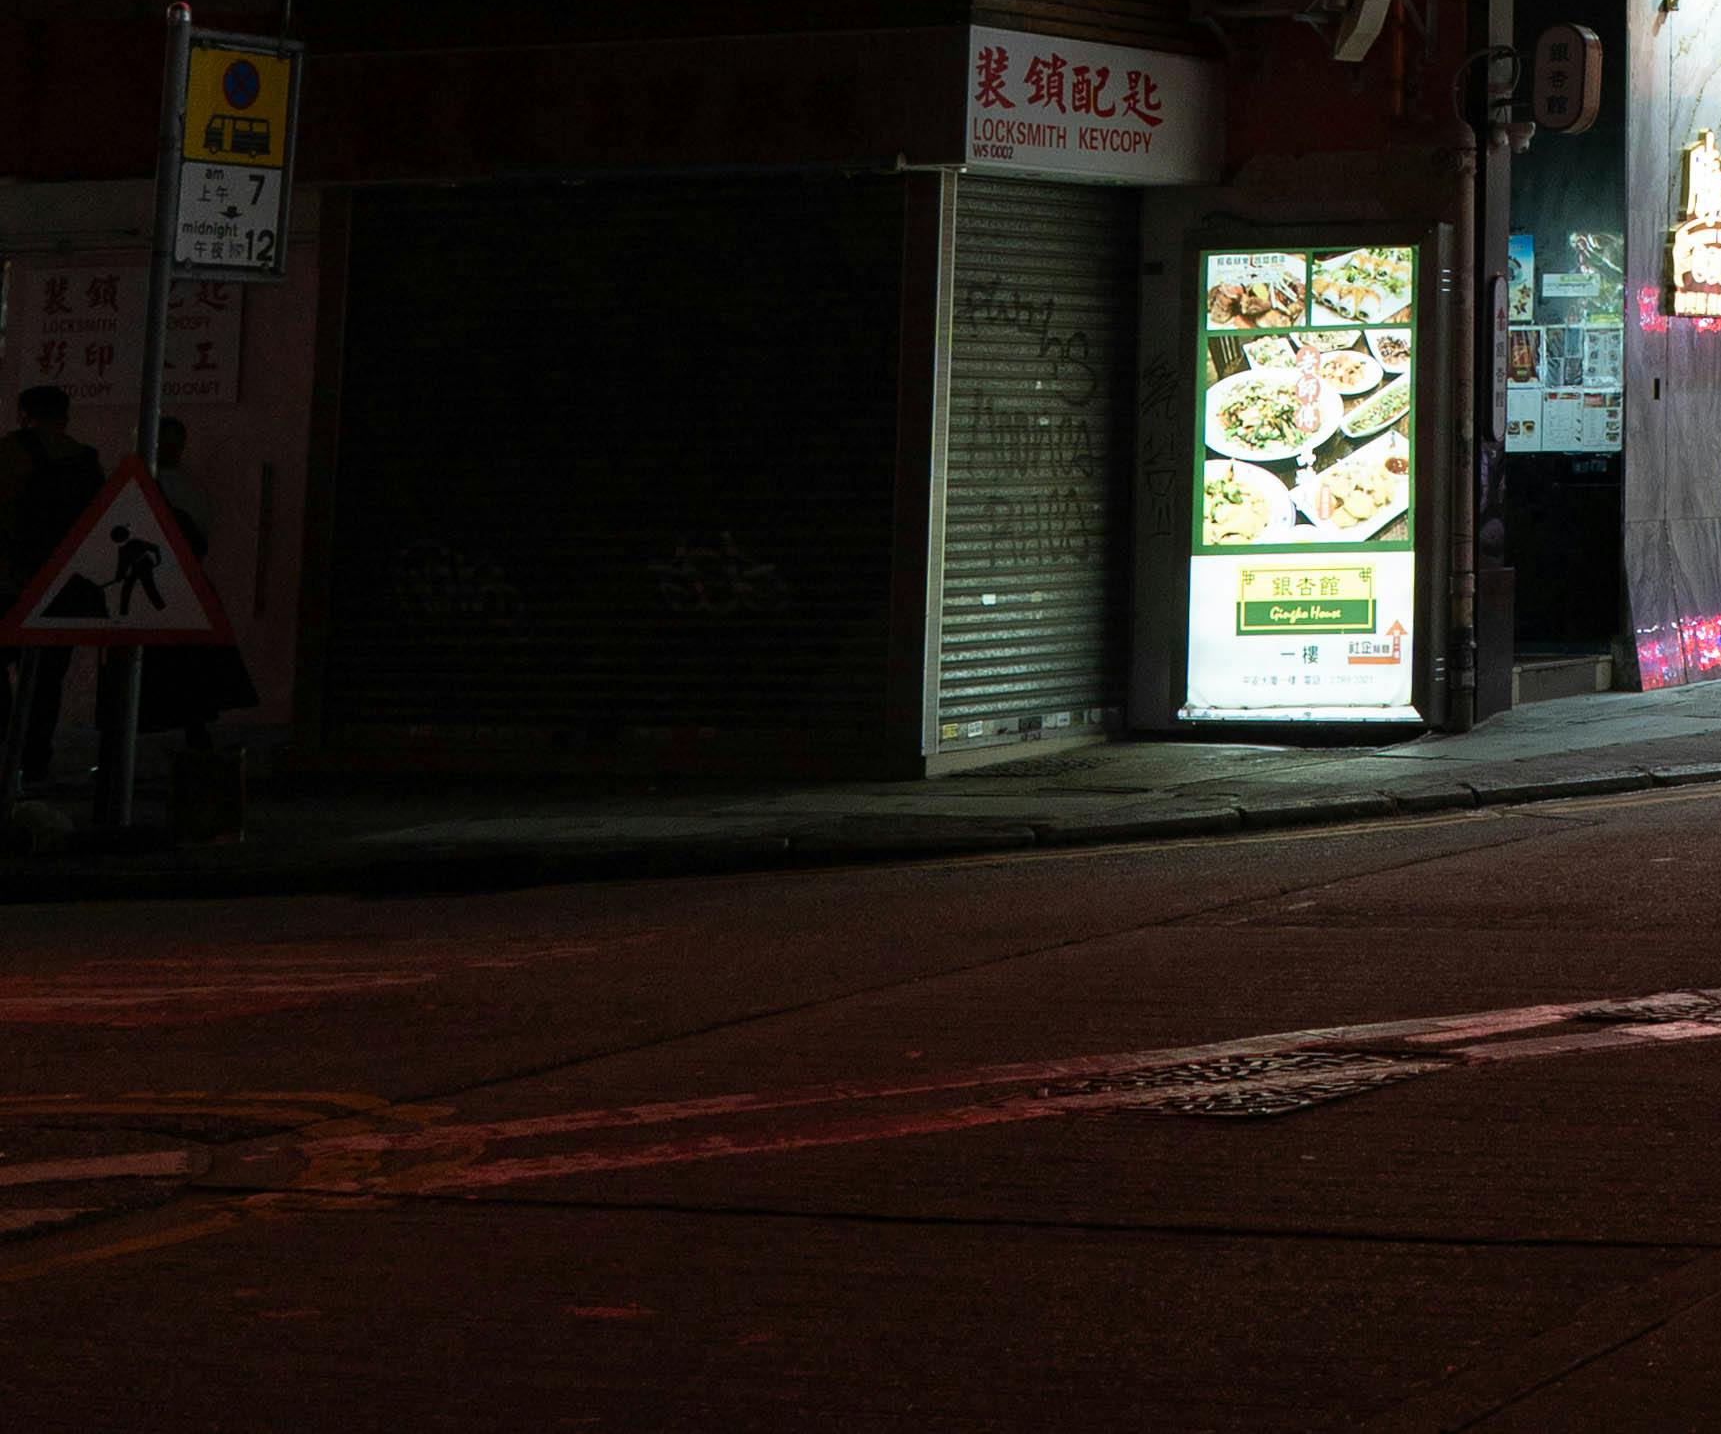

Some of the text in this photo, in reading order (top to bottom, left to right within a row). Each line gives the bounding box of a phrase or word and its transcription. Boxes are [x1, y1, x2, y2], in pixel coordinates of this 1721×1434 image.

[974, 46, 1164, 128] 裝鎖配匙
[973, 117, 1153, 154] LOCKSMITH KEYCOPY
[205, 168, 224, 180] am
[197, 184, 228, 203] 上午
[249, 174, 265, 205] 7
[182, 220, 239, 239] midnight
[245, 229, 274, 261] 12
[1272, 576, 1341, 596] 銀杏館
[1311, 606, 1341, 619] House
[1280, 645, 1319, 665] 一樓
